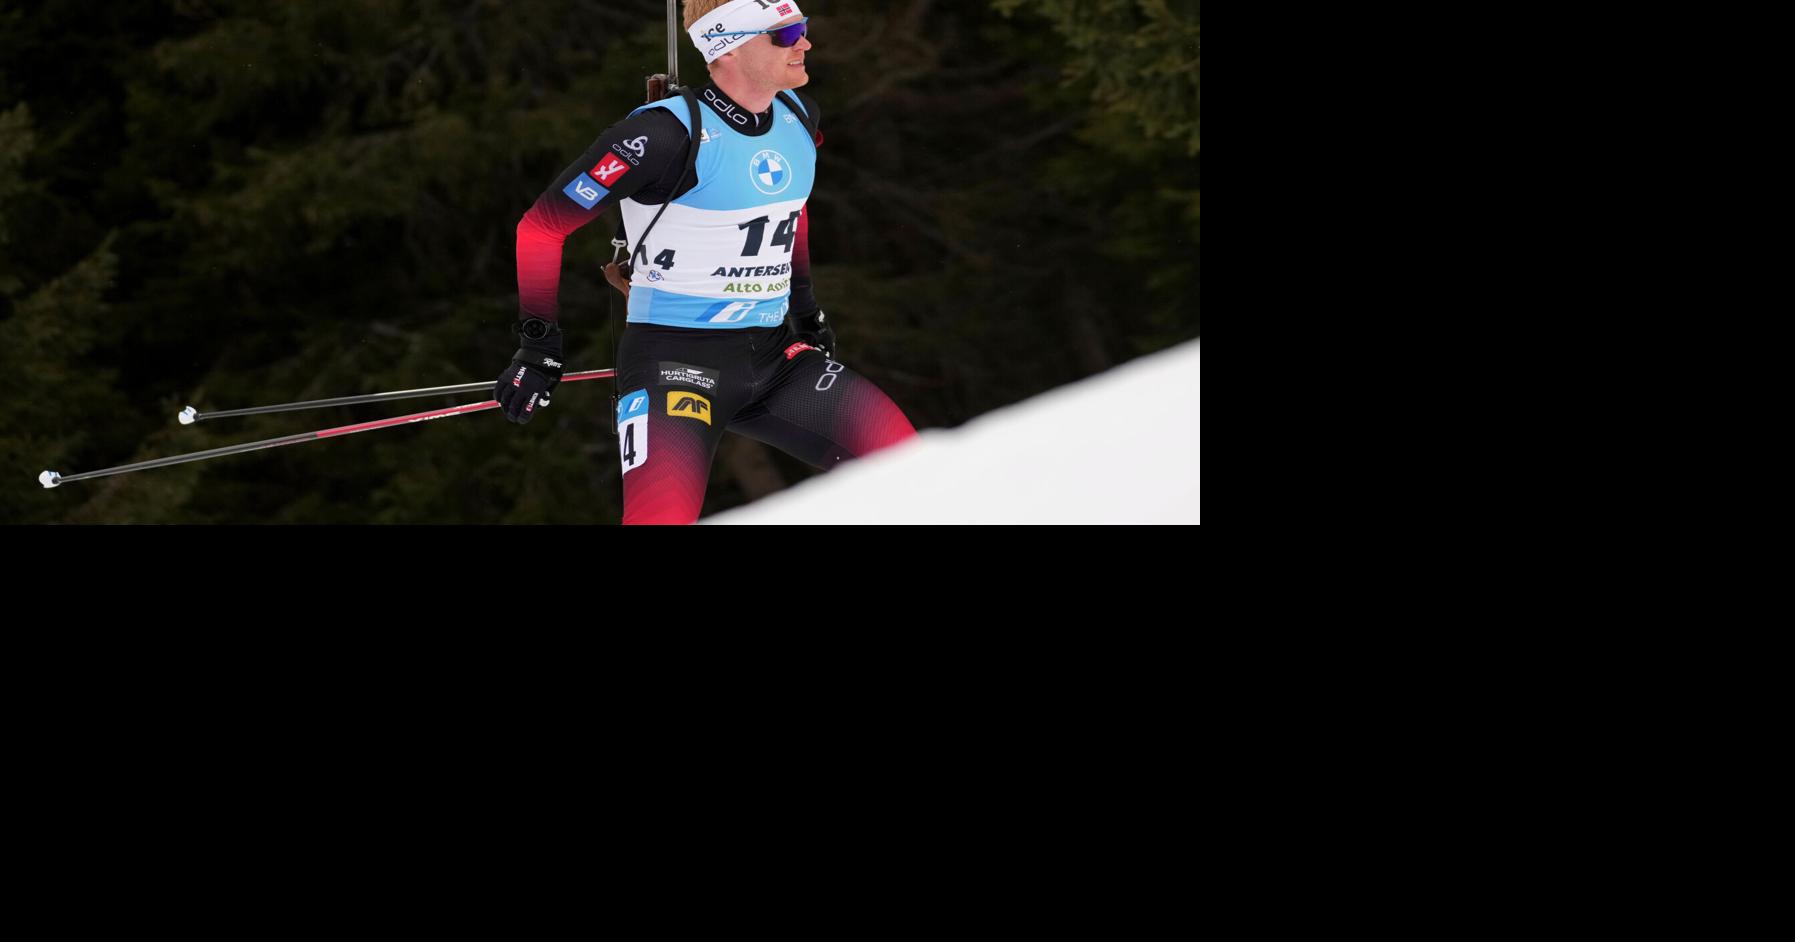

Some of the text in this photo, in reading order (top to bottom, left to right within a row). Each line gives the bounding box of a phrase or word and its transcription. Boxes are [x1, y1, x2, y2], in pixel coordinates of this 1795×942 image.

[703, 88, 748, 125] odlo
[611, 143, 640, 166] odlo
[738, 209, 802, 257] 14
[660, 370, 716, 385] HURTIGRUTA
[623, 422, 637, 467] 4
